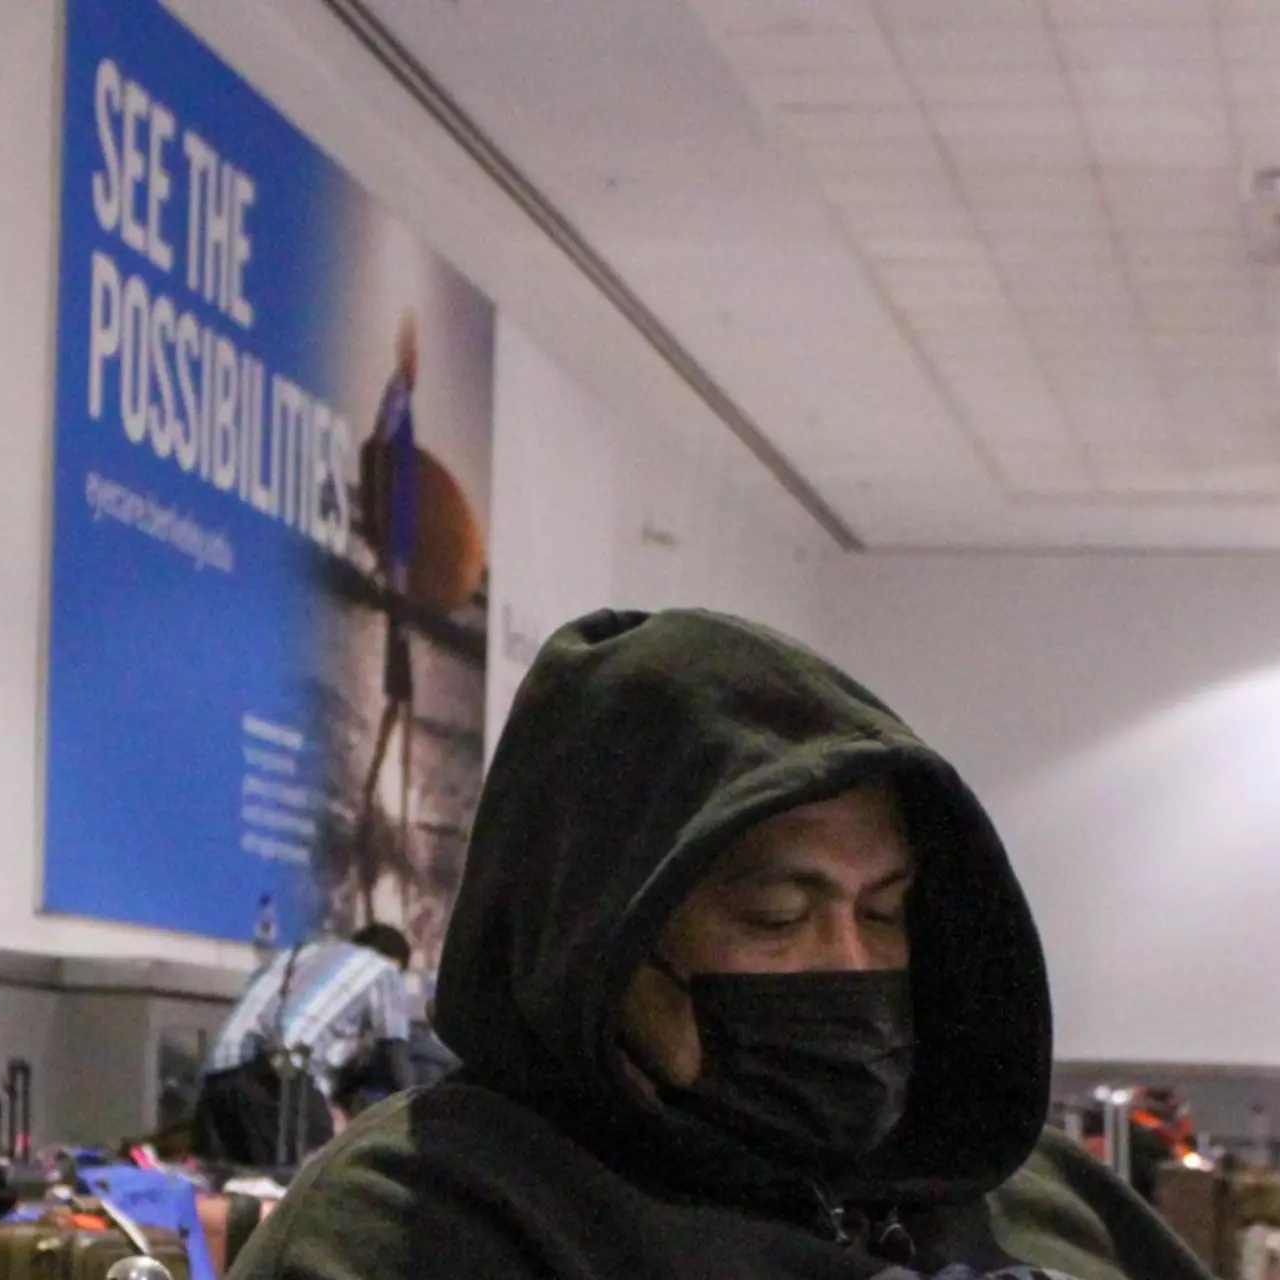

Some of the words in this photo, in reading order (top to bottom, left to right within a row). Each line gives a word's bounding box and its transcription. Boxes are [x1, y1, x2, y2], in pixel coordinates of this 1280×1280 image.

[92, 58, 175, 273] SEE
[183, 130, 255, 328] THE
[88, 251, 350, 554] POSSIBILITIES
